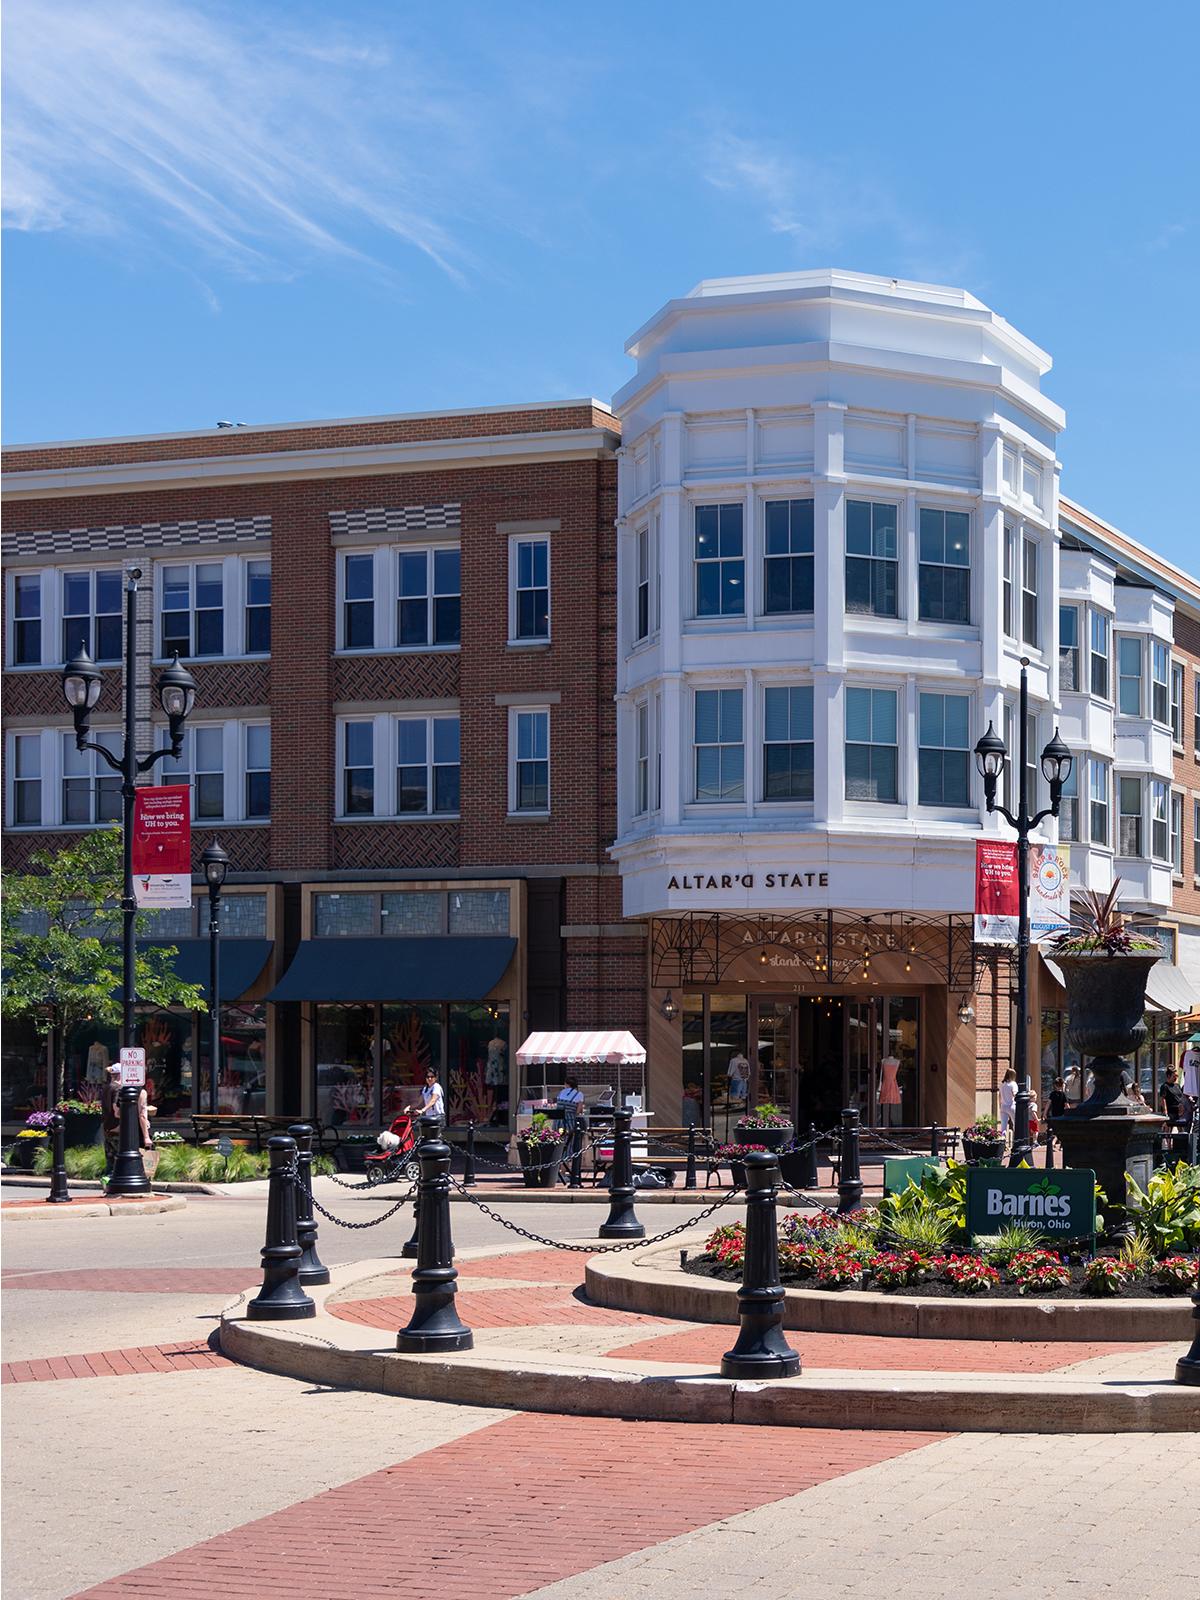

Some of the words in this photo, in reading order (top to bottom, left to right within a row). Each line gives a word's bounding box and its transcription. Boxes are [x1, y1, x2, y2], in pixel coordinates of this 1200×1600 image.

[140, 813, 155, 821] How
[165, 811, 185, 821] bring
[164, 821, 180, 829] you.
[1001, 864, 1014, 872] bring
[1032, 855, 1046, 878] SHOP
[667, 874, 754, 890] ALTAR'D
[765, 872, 829, 888] STATE
[837, 932, 895, 947] STATE
[768, 952, 800, 967] stand
[127, 1050, 138, 1059] NO
[987, 1188, 1071, 1217] Barnes
[1013, 1218, 1046, 1230] Huron,
[1047, 1218, 1071, 1229] Ohio
